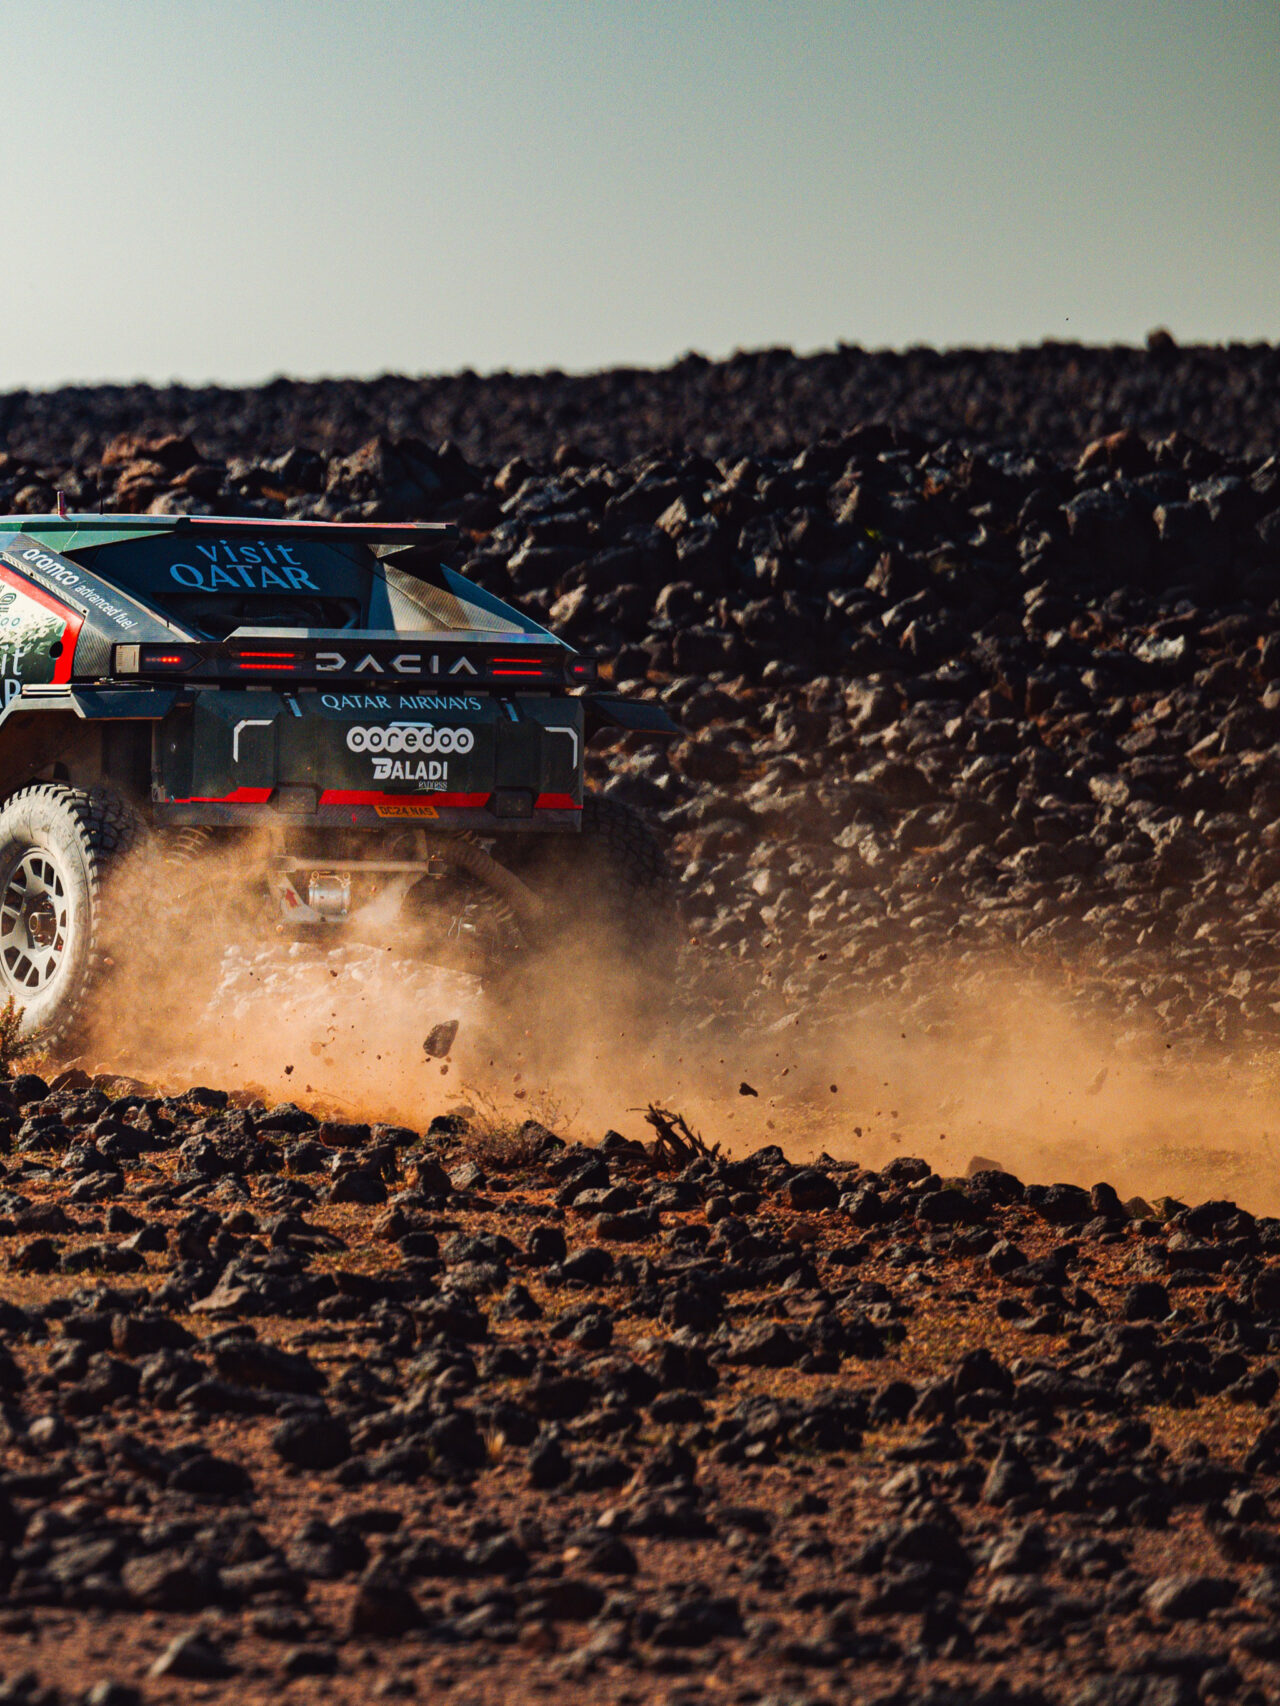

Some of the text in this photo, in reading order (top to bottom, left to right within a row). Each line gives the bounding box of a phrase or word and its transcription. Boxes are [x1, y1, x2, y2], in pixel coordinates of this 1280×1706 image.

[196, 540, 301, 565] visit
[23, 548, 138, 630] aramco advanced fuel
[170, 563, 320, 592] QATAR
[316, 652, 478, 675] DACIA
[321, 694, 482, 711] QATAR AIRWAYS
[349, 727, 472, 750] ooredoo
[371, 757, 448, 780] BALADI
